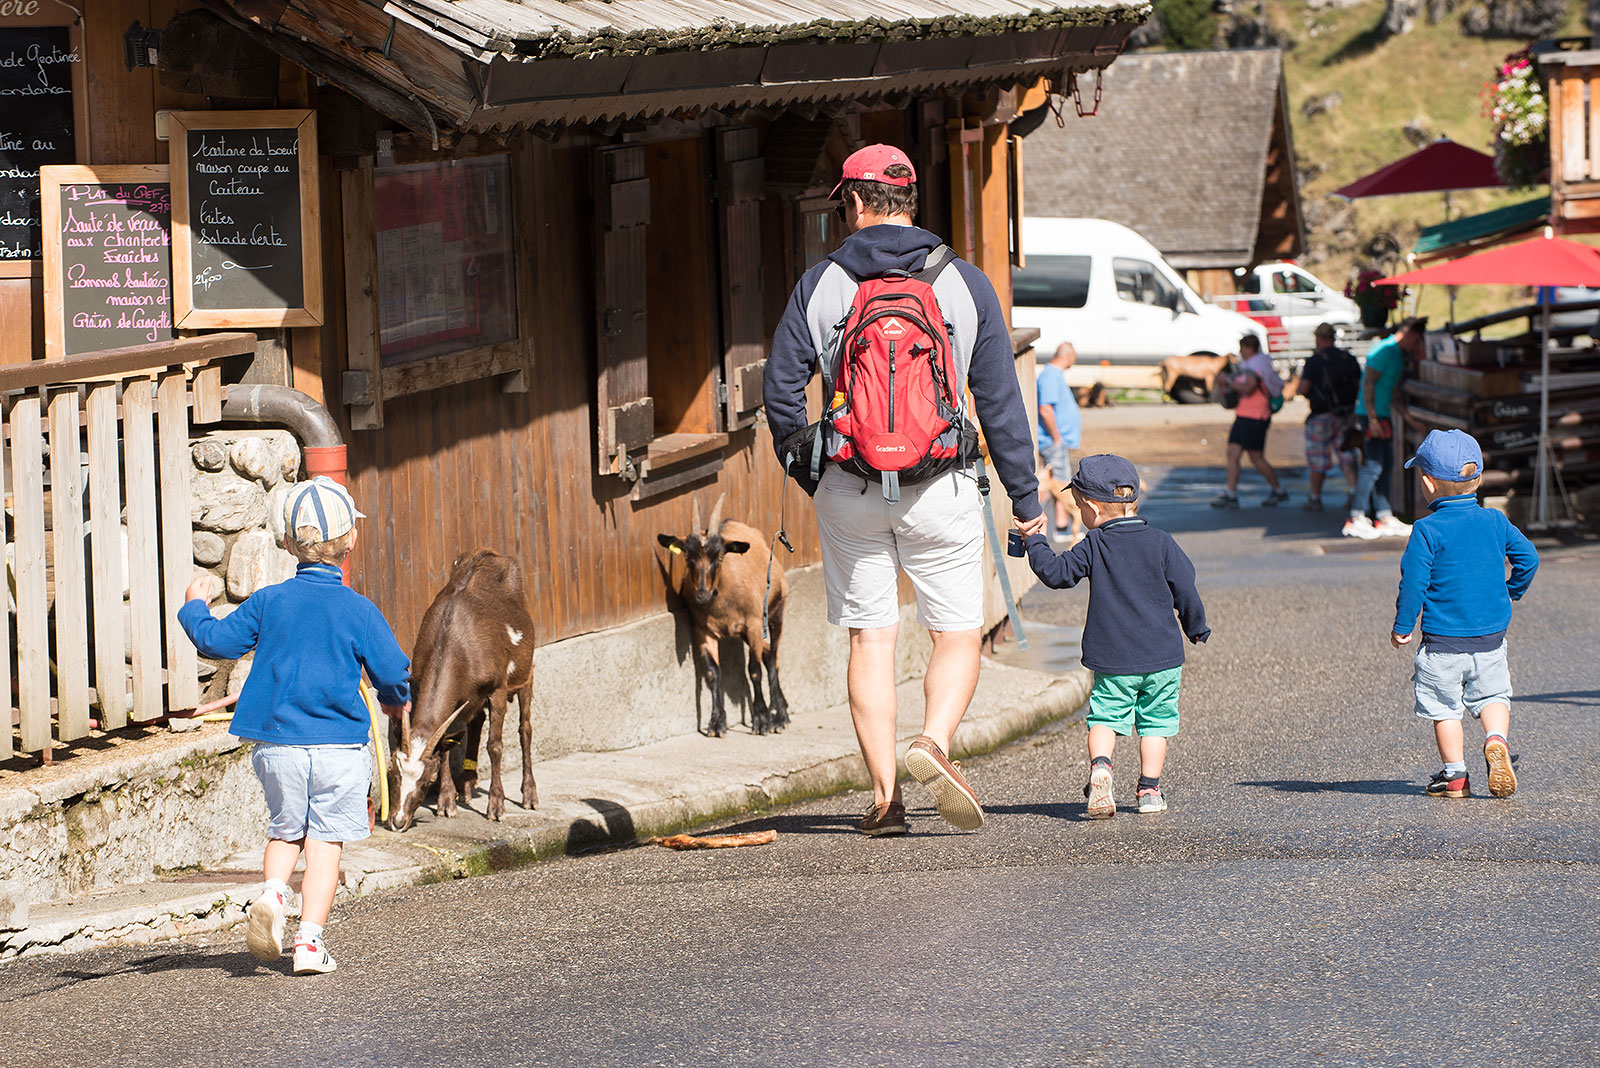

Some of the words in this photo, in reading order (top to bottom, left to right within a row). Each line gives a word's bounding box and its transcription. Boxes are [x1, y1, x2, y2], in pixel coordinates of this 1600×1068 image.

[32, 140, 56, 150] au
[249, 136, 265, 156] de
[274, 165, 290, 173] au
[115, 186, 131, 199] du
[106, 213, 126, 232] de
[67, 237, 95, 247] aux
[156, 288, 171, 305] et
[116, 311, 132, 329] de
[875, 444, 898, 453] Gradient
